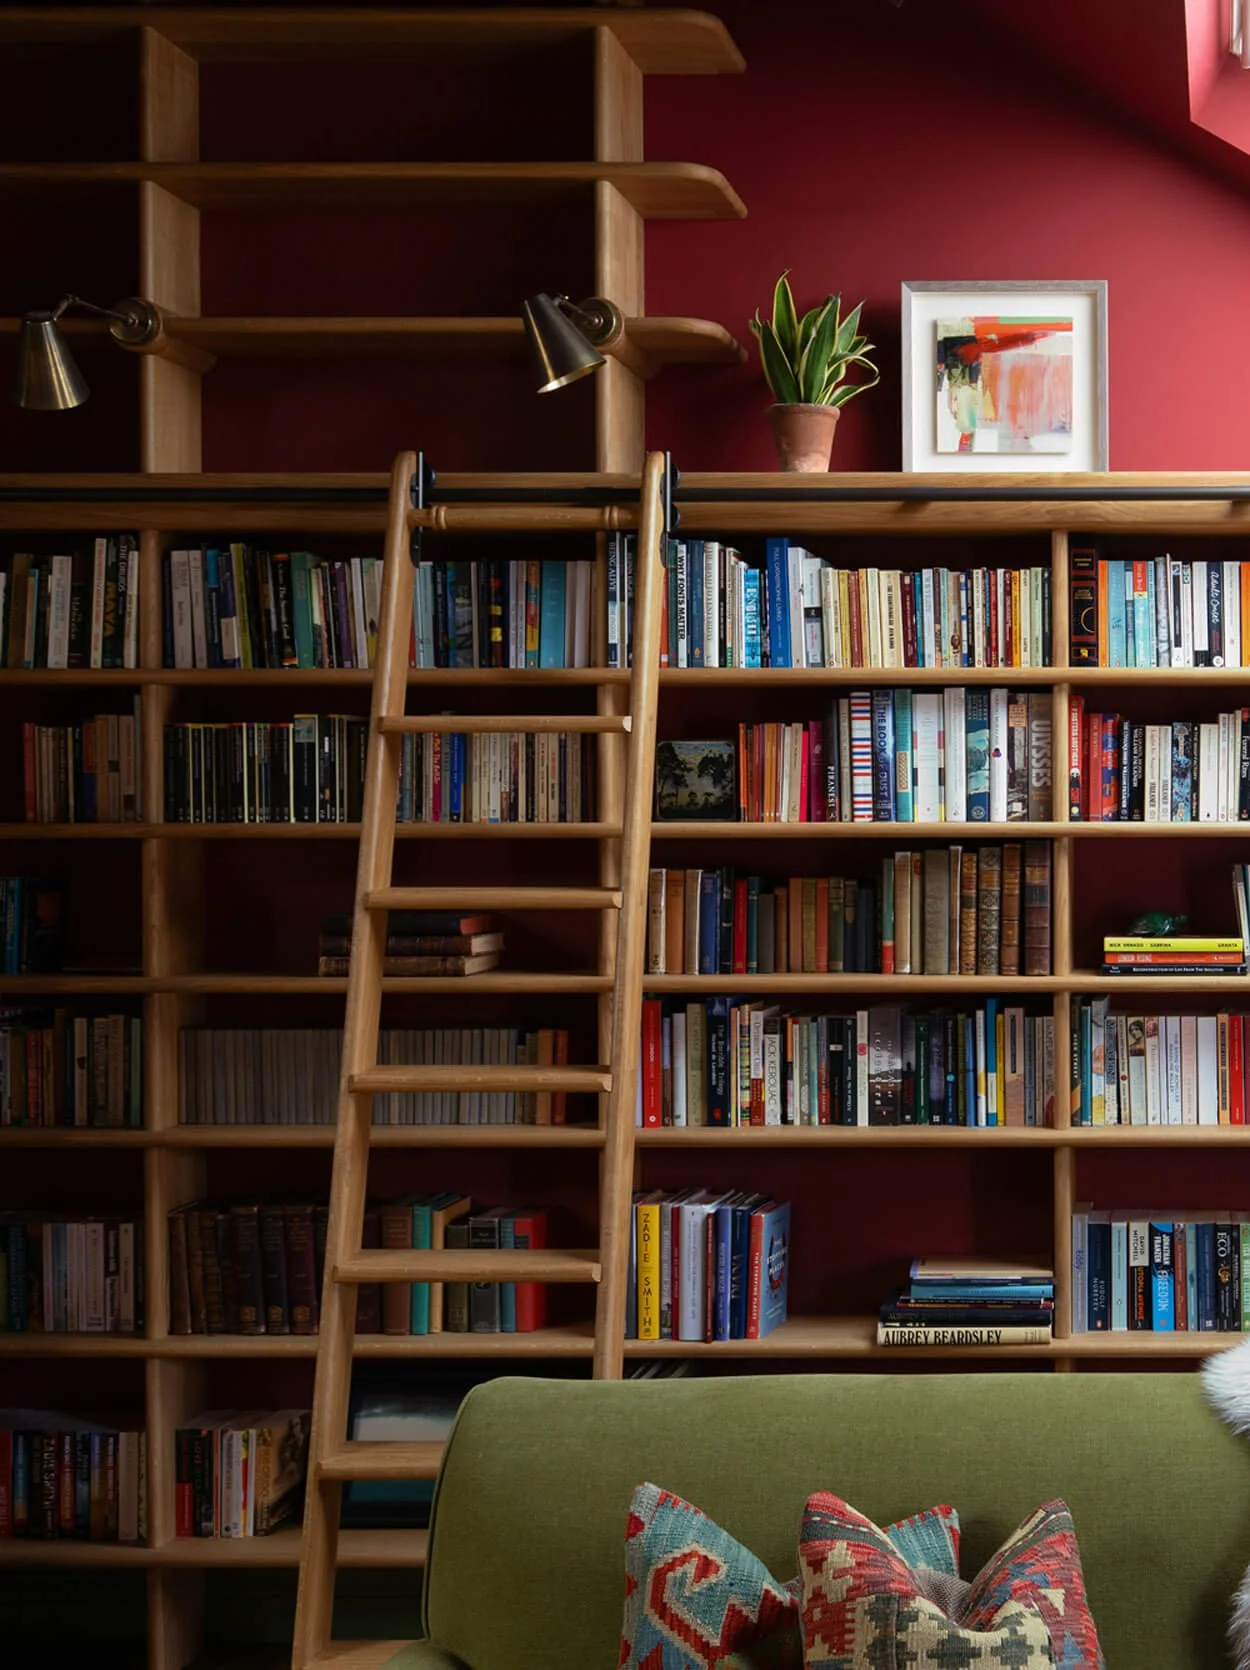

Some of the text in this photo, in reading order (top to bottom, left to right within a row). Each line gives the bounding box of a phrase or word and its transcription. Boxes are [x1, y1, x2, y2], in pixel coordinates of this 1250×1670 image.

[609, 569, 617, 592] ALIVE
[678, 577, 686, 606] FONTS
[678, 607, 686, 641] MATTER
[878, 706, 887, 723] THE
[879, 726, 888, 754] BOOK
[1031, 719, 1051, 788] ULYSSES
[1241, 736, 1250, 761] Funeral
[827, 766, 836, 807] PIRANESI
[881, 772, 889, 798] DUST
[767, 1037, 778, 1105] JACK KEROUAC
[1154, 1236, 1162, 1263] FRANZEN
[1162, 1233, 1171, 1265] JONATHAN
[1217, 1231, 1227, 1257] ECO
[644, 1276, 653, 1326] SMITH
[1157, 1270, 1169, 1312] FREEDOM
[884, 1330, 1002, 1344] AUBREY BEARDSLEY
